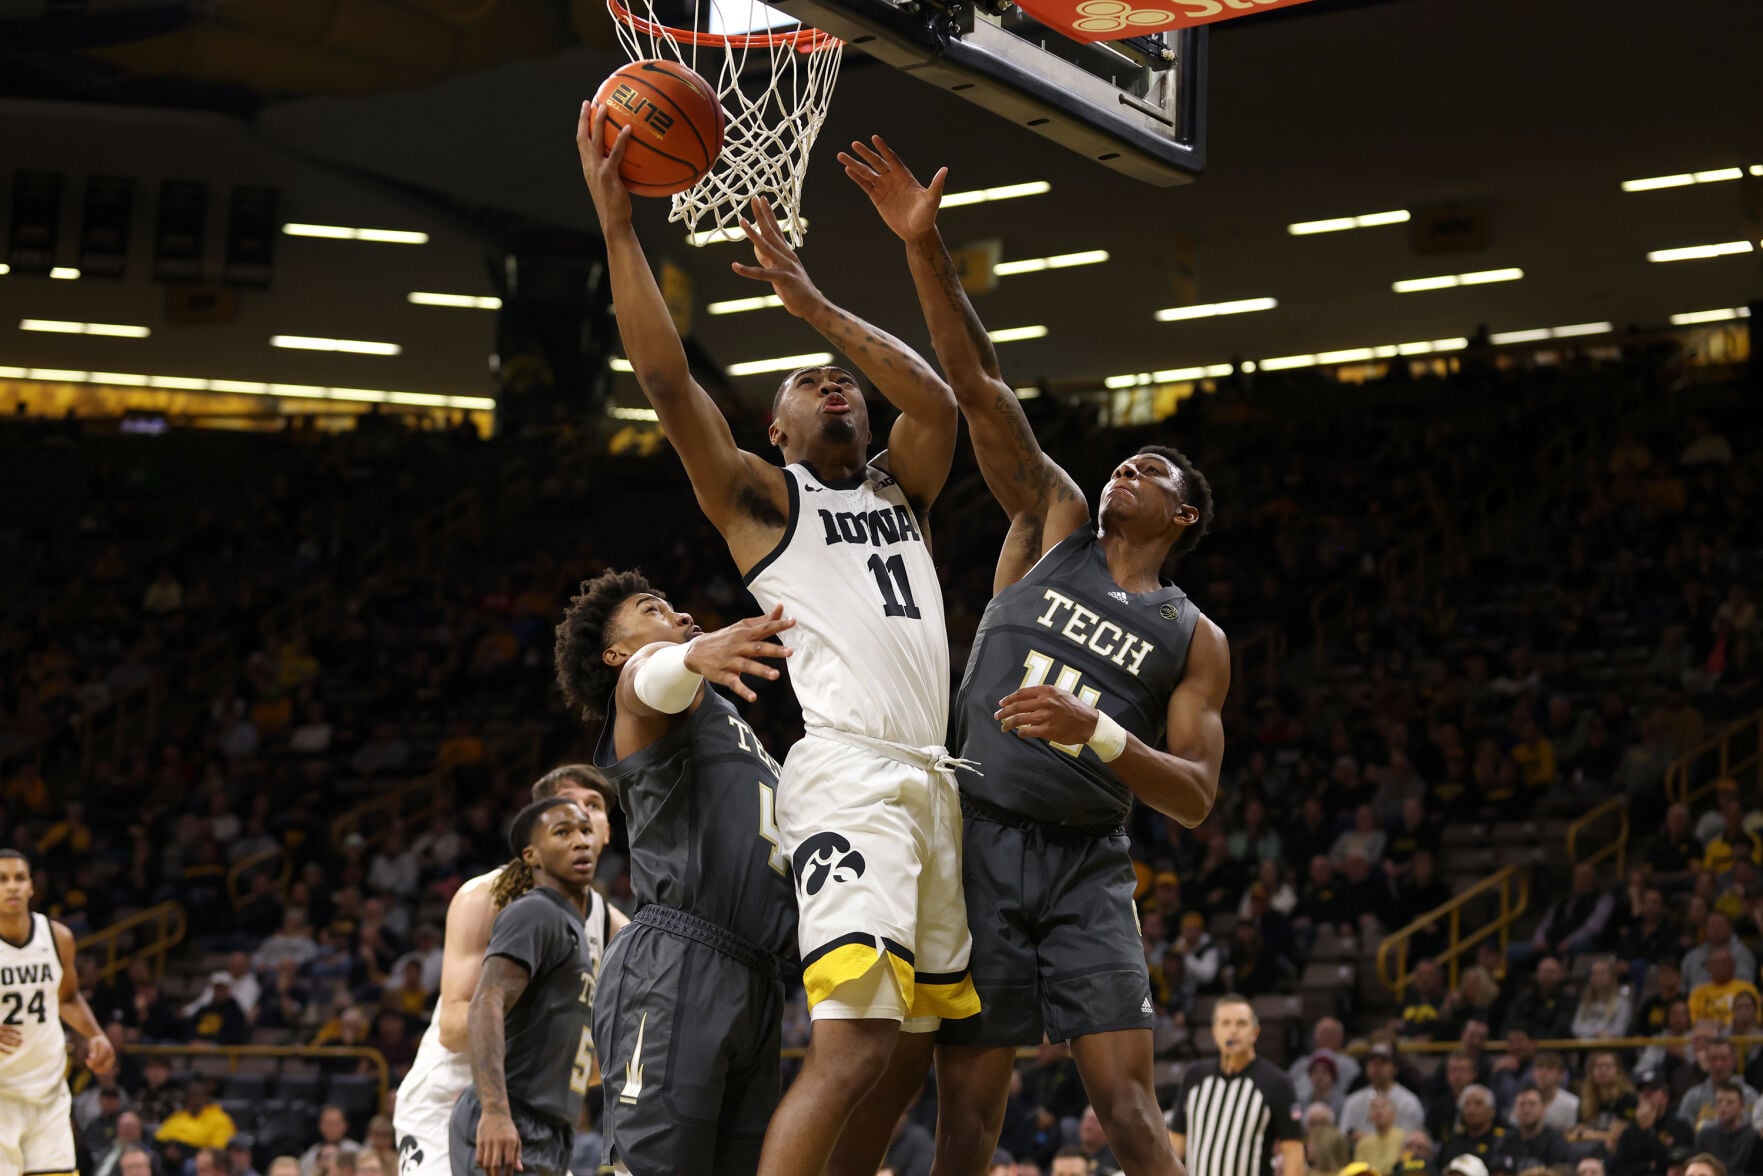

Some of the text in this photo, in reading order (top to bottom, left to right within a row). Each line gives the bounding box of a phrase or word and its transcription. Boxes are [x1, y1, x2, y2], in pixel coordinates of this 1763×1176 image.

[817, 504, 921, 547] IOWA
[866, 553, 922, 620] 11
[1036, 588, 1154, 677] TECH
[2, 989, 46, 1026] 24
[569, 1024, 596, 1096] 5
